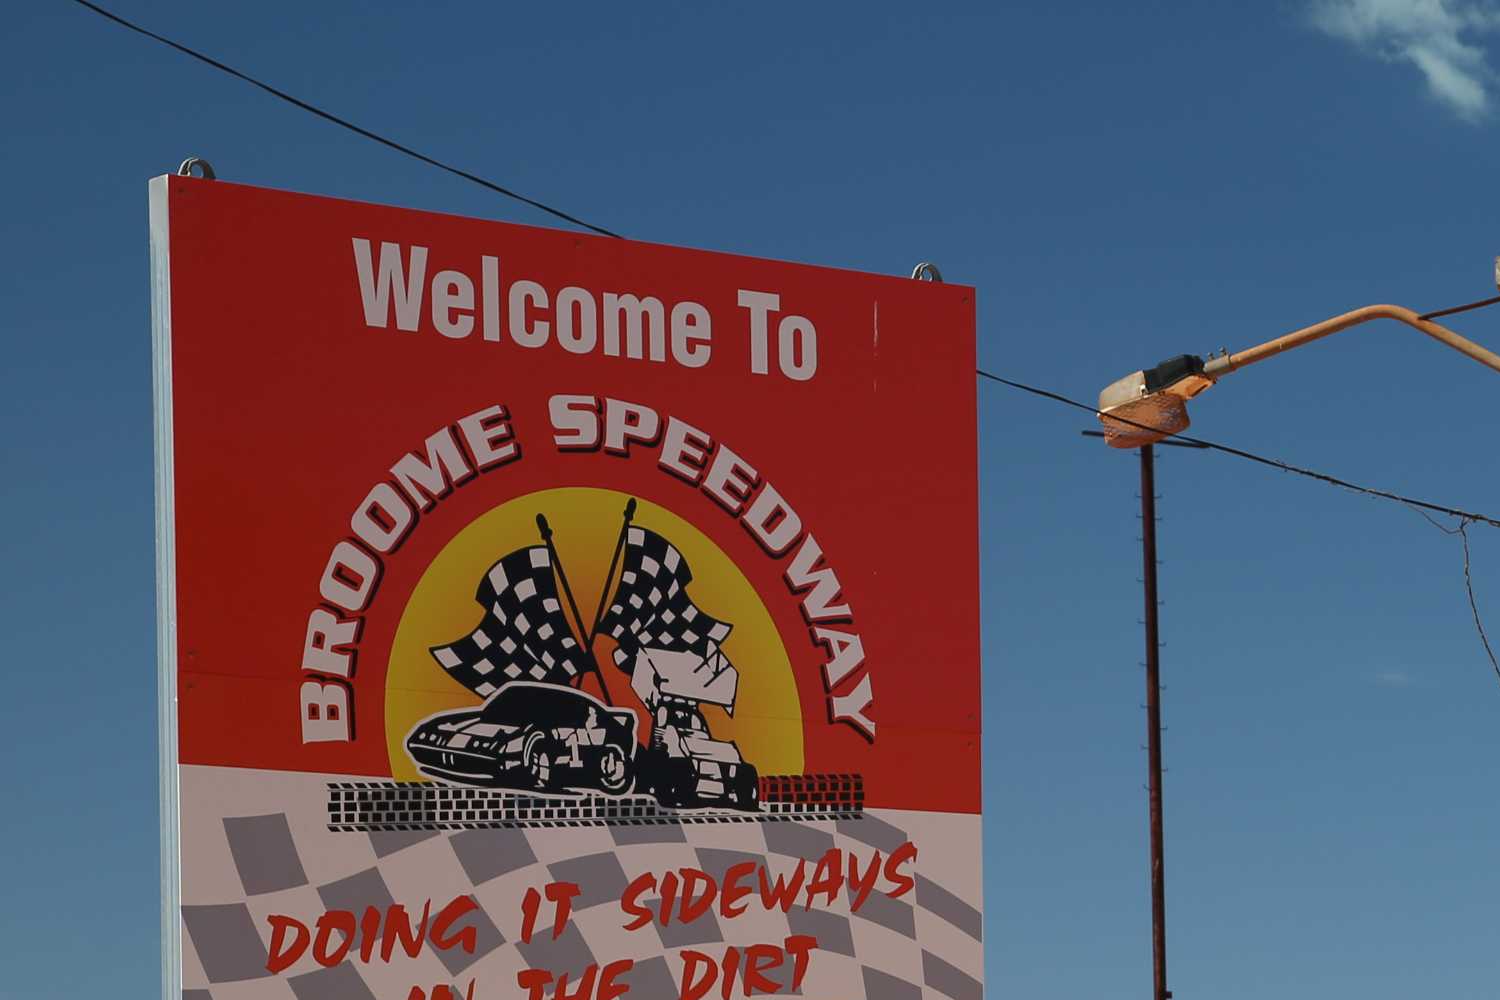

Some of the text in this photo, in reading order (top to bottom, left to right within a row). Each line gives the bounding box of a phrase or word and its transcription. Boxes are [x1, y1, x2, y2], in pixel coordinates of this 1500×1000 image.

[352, 238, 818, 381] Welcome To
[300, 394, 878, 745] BROOME SPEEDWAY
[265, 841, 919, 976] DOING IT SIDEWAYS
